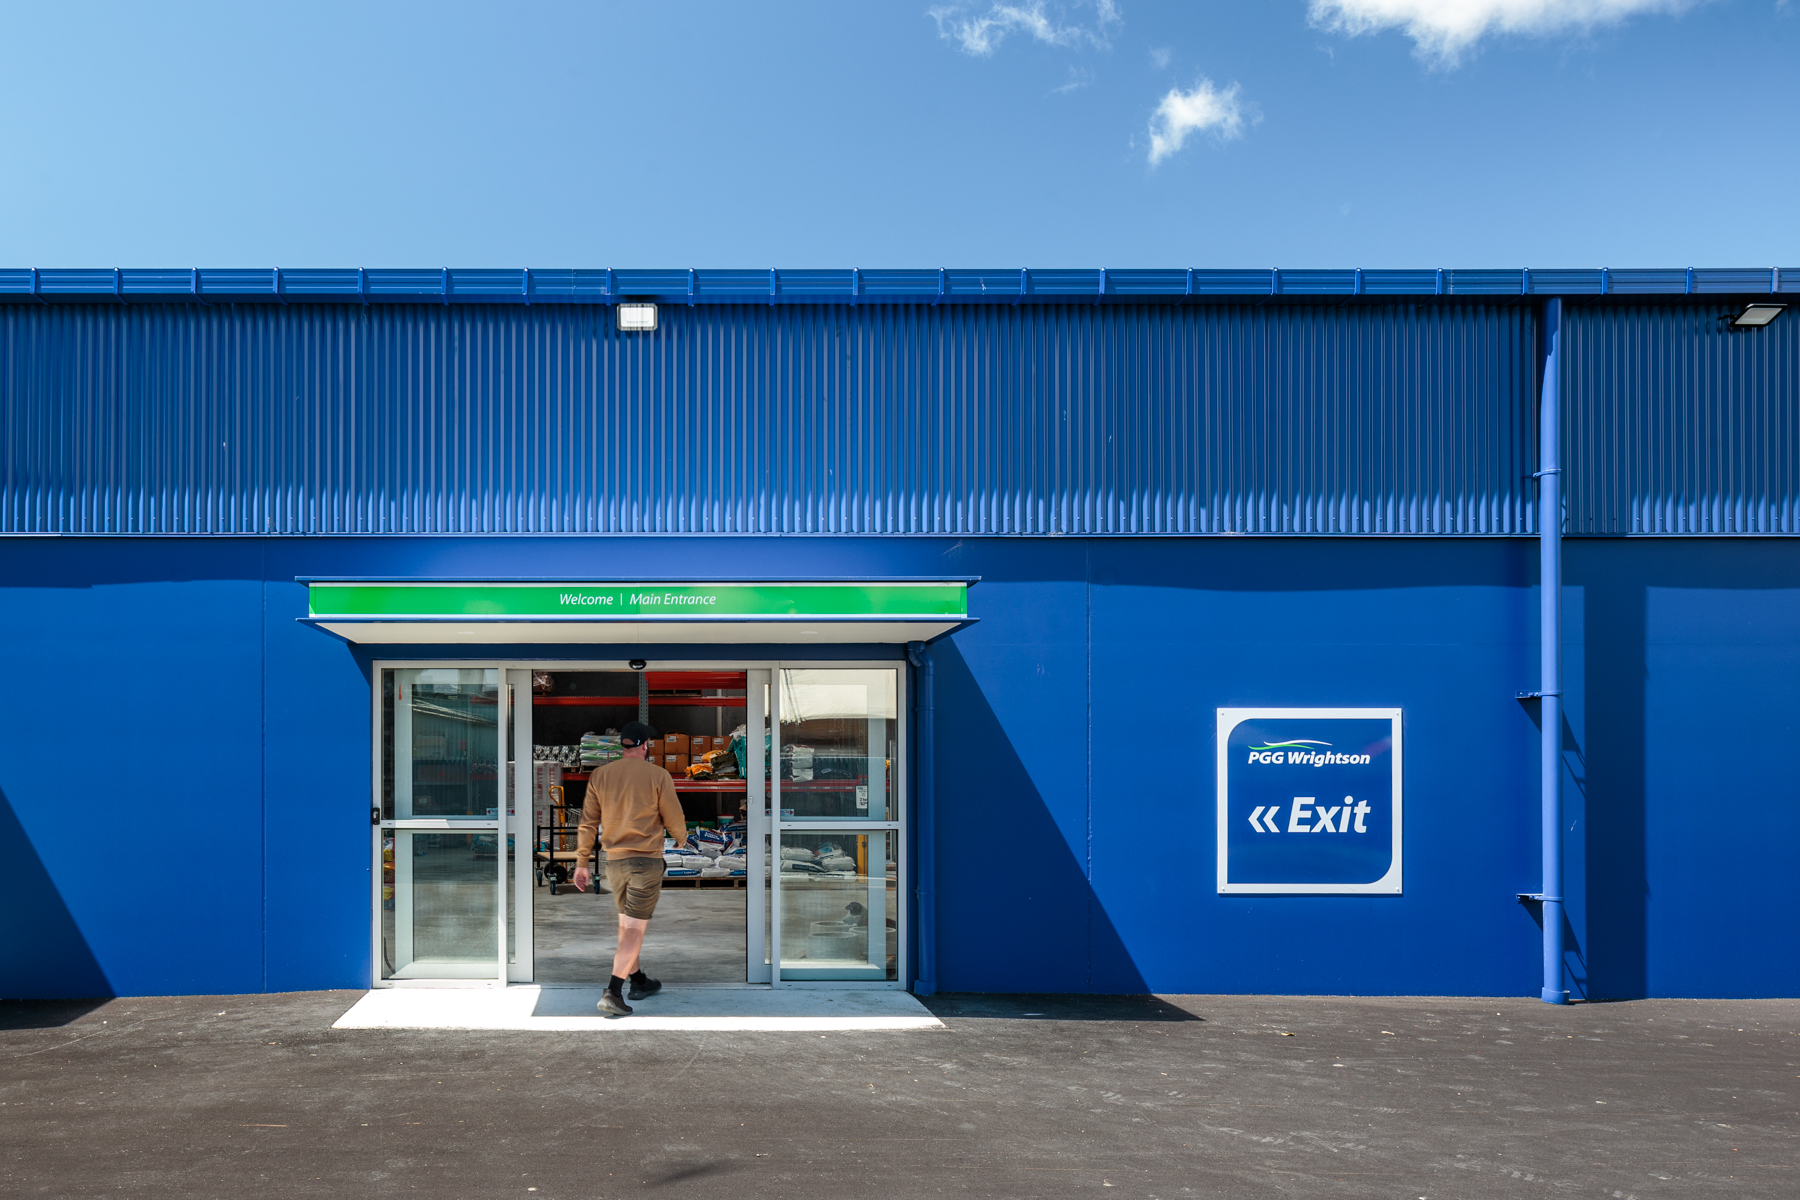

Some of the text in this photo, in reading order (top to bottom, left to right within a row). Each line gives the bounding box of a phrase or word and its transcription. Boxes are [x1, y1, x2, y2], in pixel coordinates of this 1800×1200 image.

[559, 593, 717, 605] Welcome Main Entrance
[1247, 751, 1371, 767] PGG Wrightson
[1287, 795, 1372, 834] Exit
